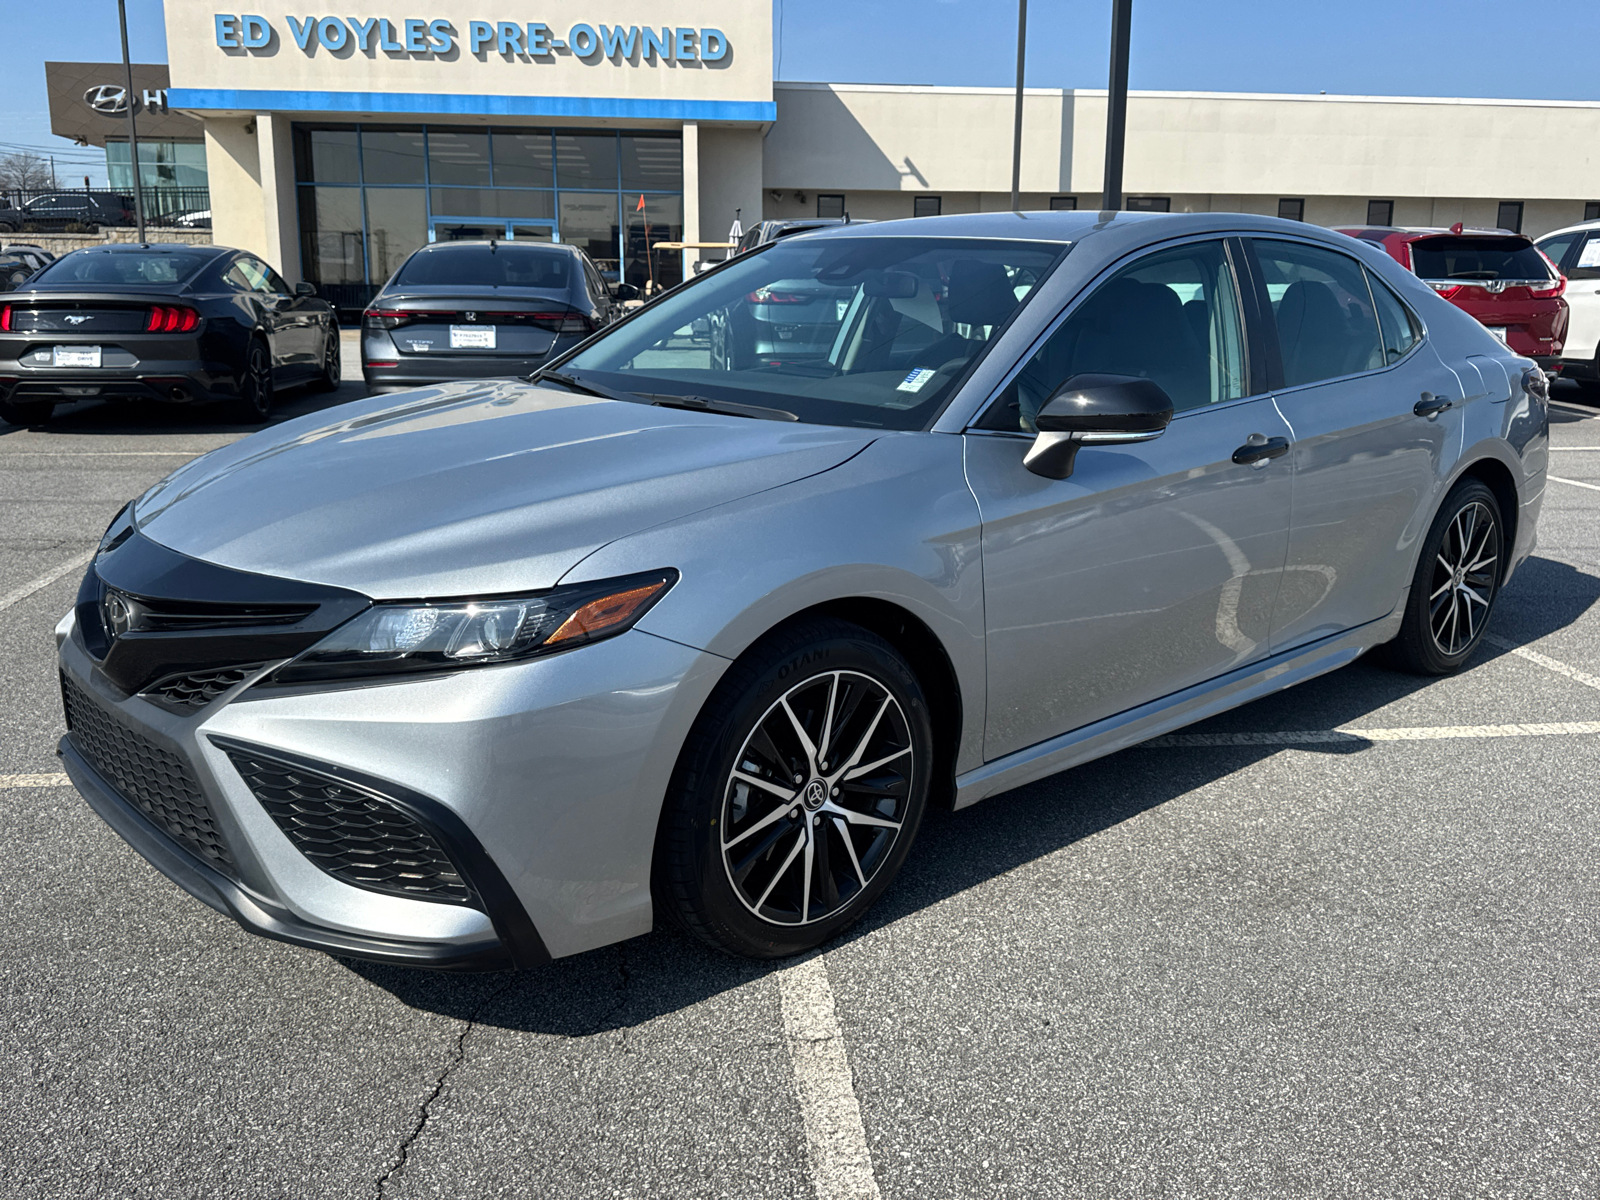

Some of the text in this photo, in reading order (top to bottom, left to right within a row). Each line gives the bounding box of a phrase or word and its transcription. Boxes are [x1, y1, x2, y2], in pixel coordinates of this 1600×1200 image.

[214, 14, 728, 61] ED VOYLES PRE-OWNED
[777, 648, 830, 679] OTANI
